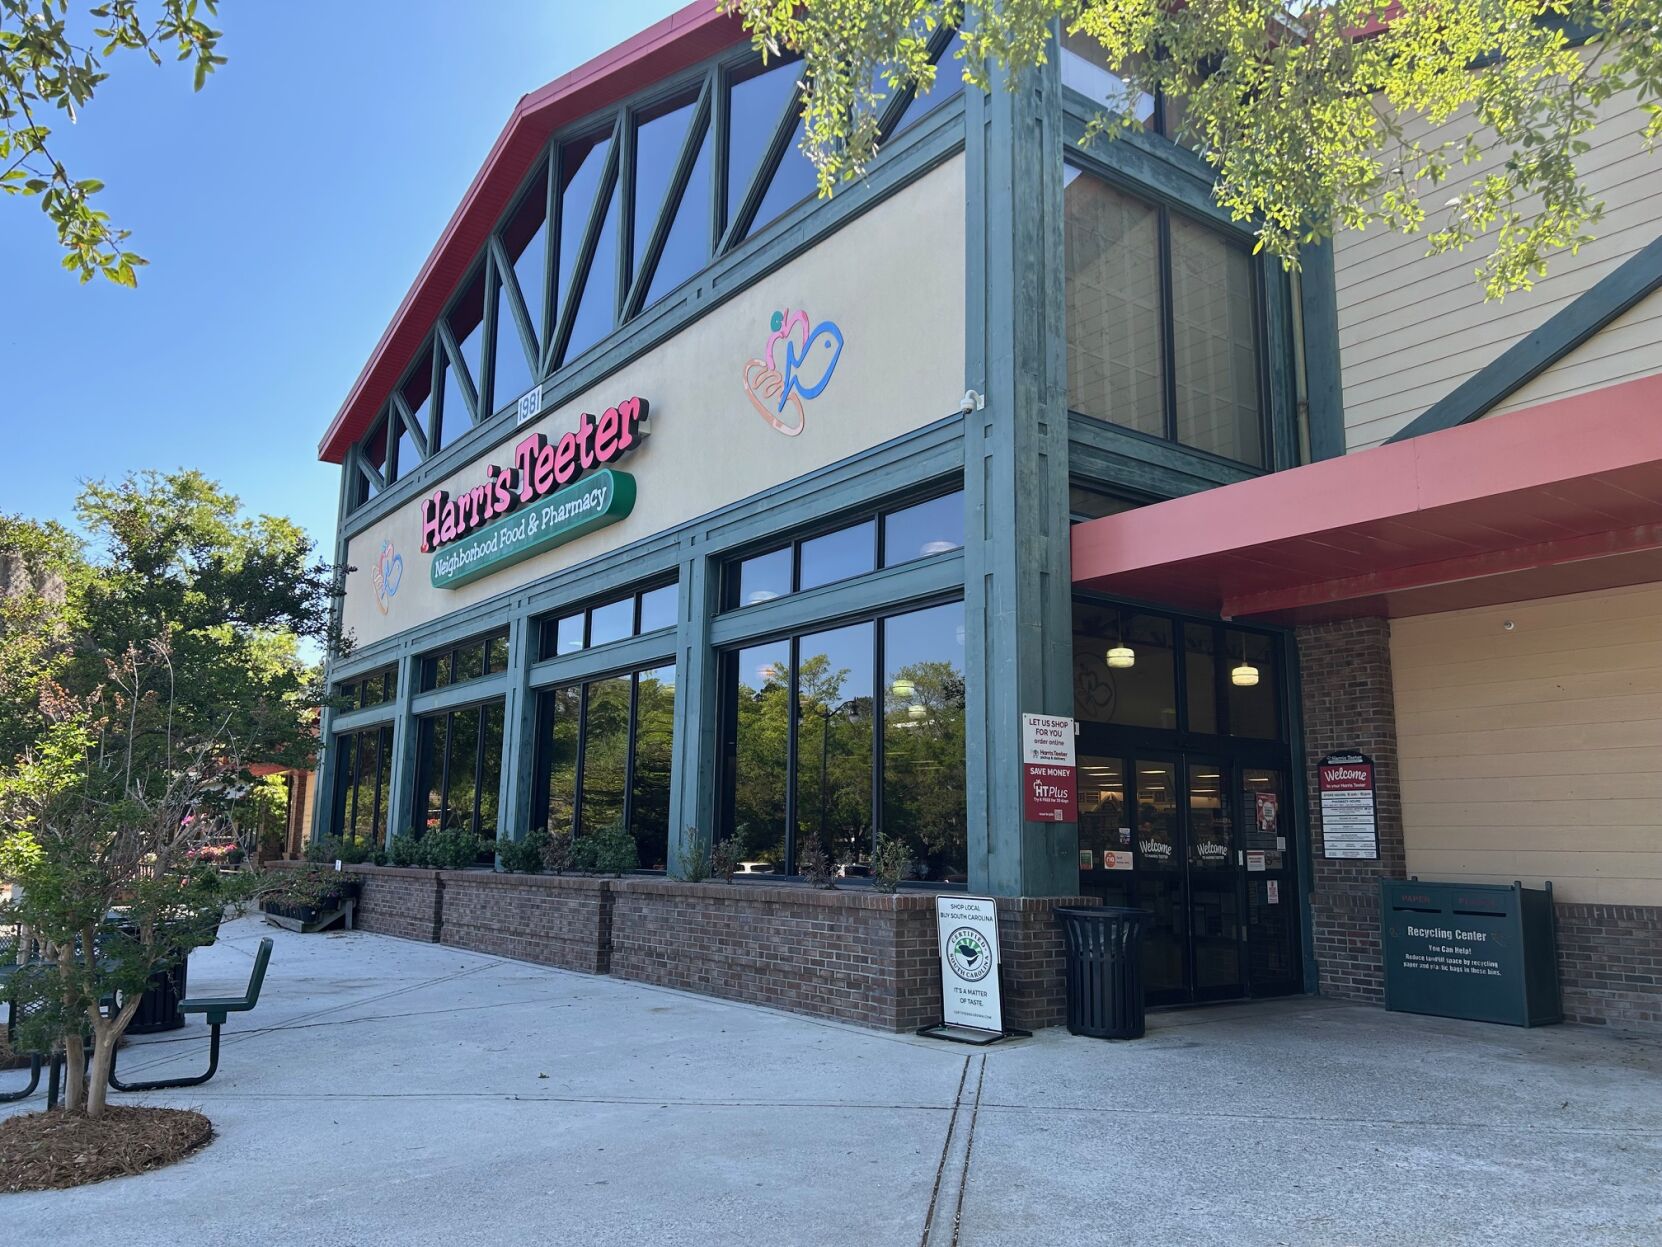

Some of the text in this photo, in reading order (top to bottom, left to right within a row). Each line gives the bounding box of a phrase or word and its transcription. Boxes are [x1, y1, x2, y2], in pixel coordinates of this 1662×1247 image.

[519, 391, 541, 421] 1981
[421, 396, 643, 553] Harris Teeter
[434, 486, 607, 578] Neighborhood Food & Pharmacy
[1051, 720, 1068, 728] SHOP
[1049, 729, 1062, 737] YOU
[1030, 767, 1070, 777] SAVE MONEY
[1324, 767, 1366, 782] Welcome
[1139, 838, 1172, 856] Welcome
[1197, 841, 1228, 856] Welcome
[951, 930, 986, 948] CERTIFIED
[1407, 926, 1486, 942] Recycling Center
[1454, 946, 1472, 955] Help!
[950, 953, 989, 978] SOUTH CAROLINA
[1471, 960, 1498, 968] recycling
